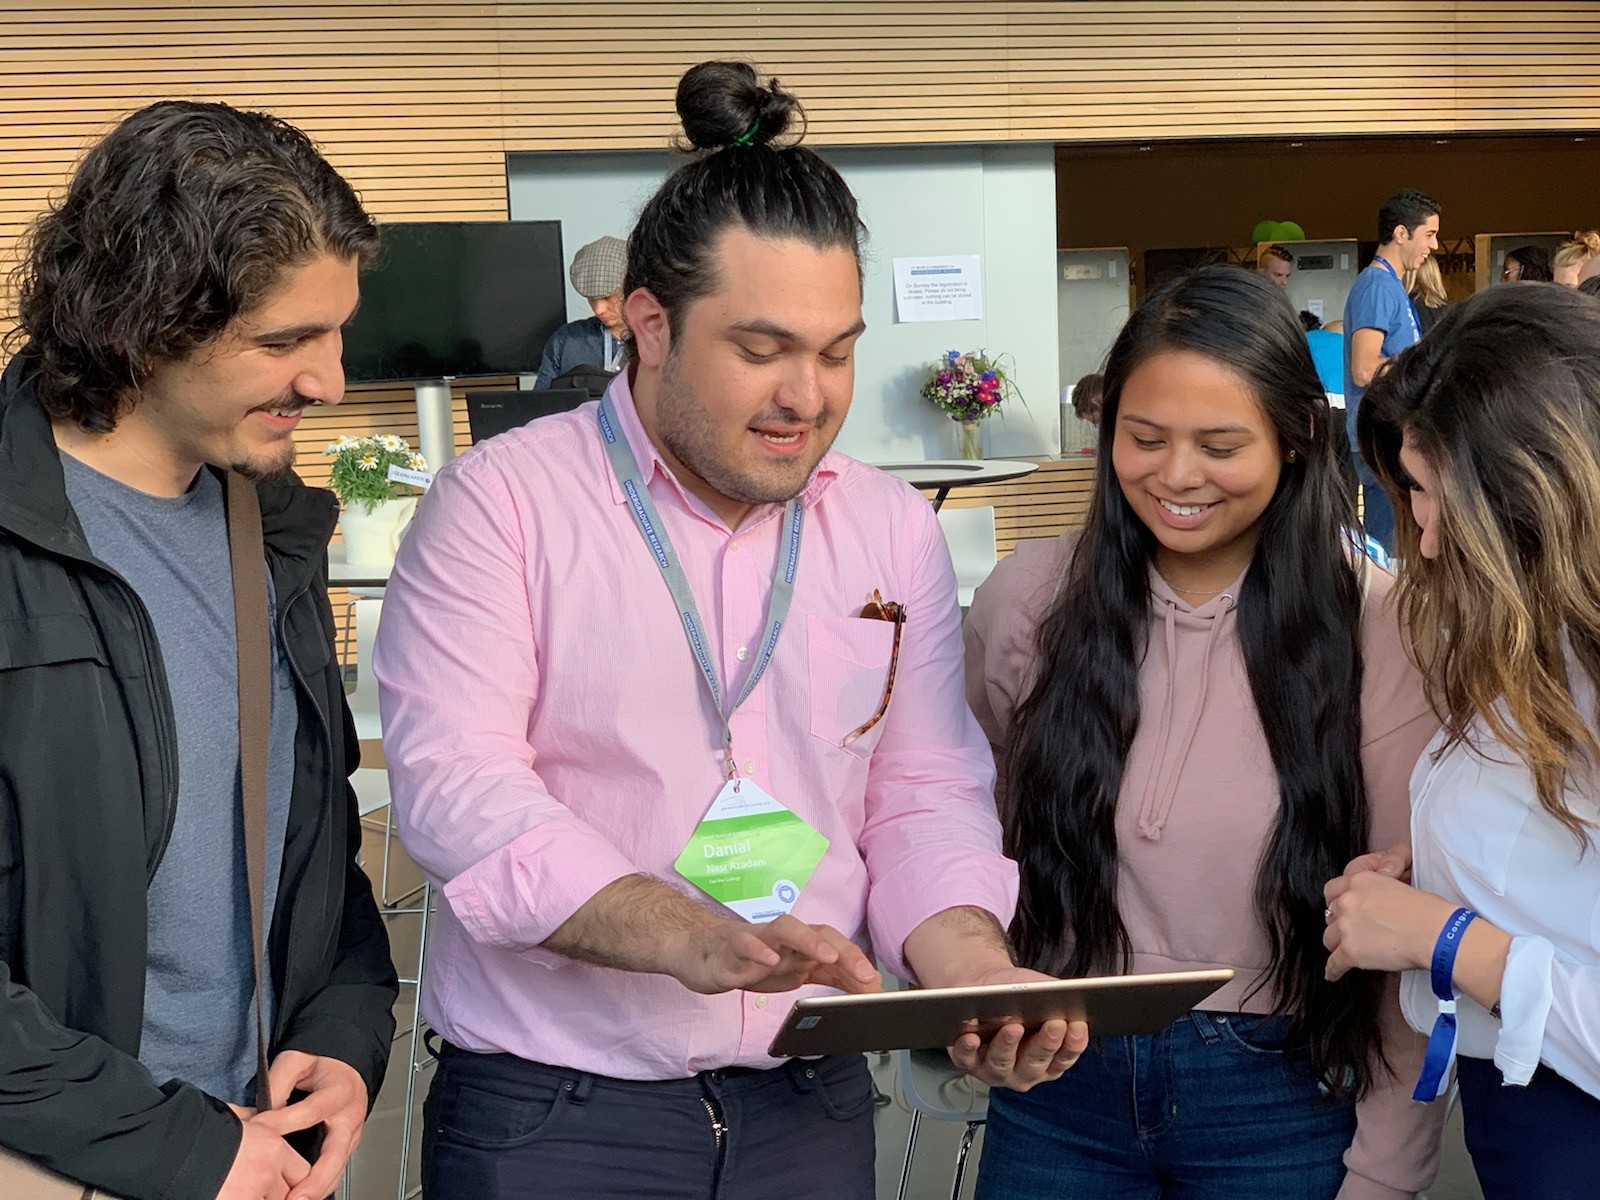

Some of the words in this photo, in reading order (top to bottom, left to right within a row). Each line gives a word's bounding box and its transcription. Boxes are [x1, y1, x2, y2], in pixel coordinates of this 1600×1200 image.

[599, 416, 615, 443] RESEARCH
[625, 480, 652, 535] UNDERGRADUATE
[649, 533, 669, 568] RESEARCH
[786, 533, 799, 583] UNDERGRADUATE
[793, 504, 803, 533] RESEARCH
[684, 612, 710, 671] UNDERGRADUATE
[766, 622, 781, 656] RESEARCH
[703, 838, 751, 859] Danial
[706, 862, 728, 874] Nasr
[729, 857, 767, 871] Azadani
